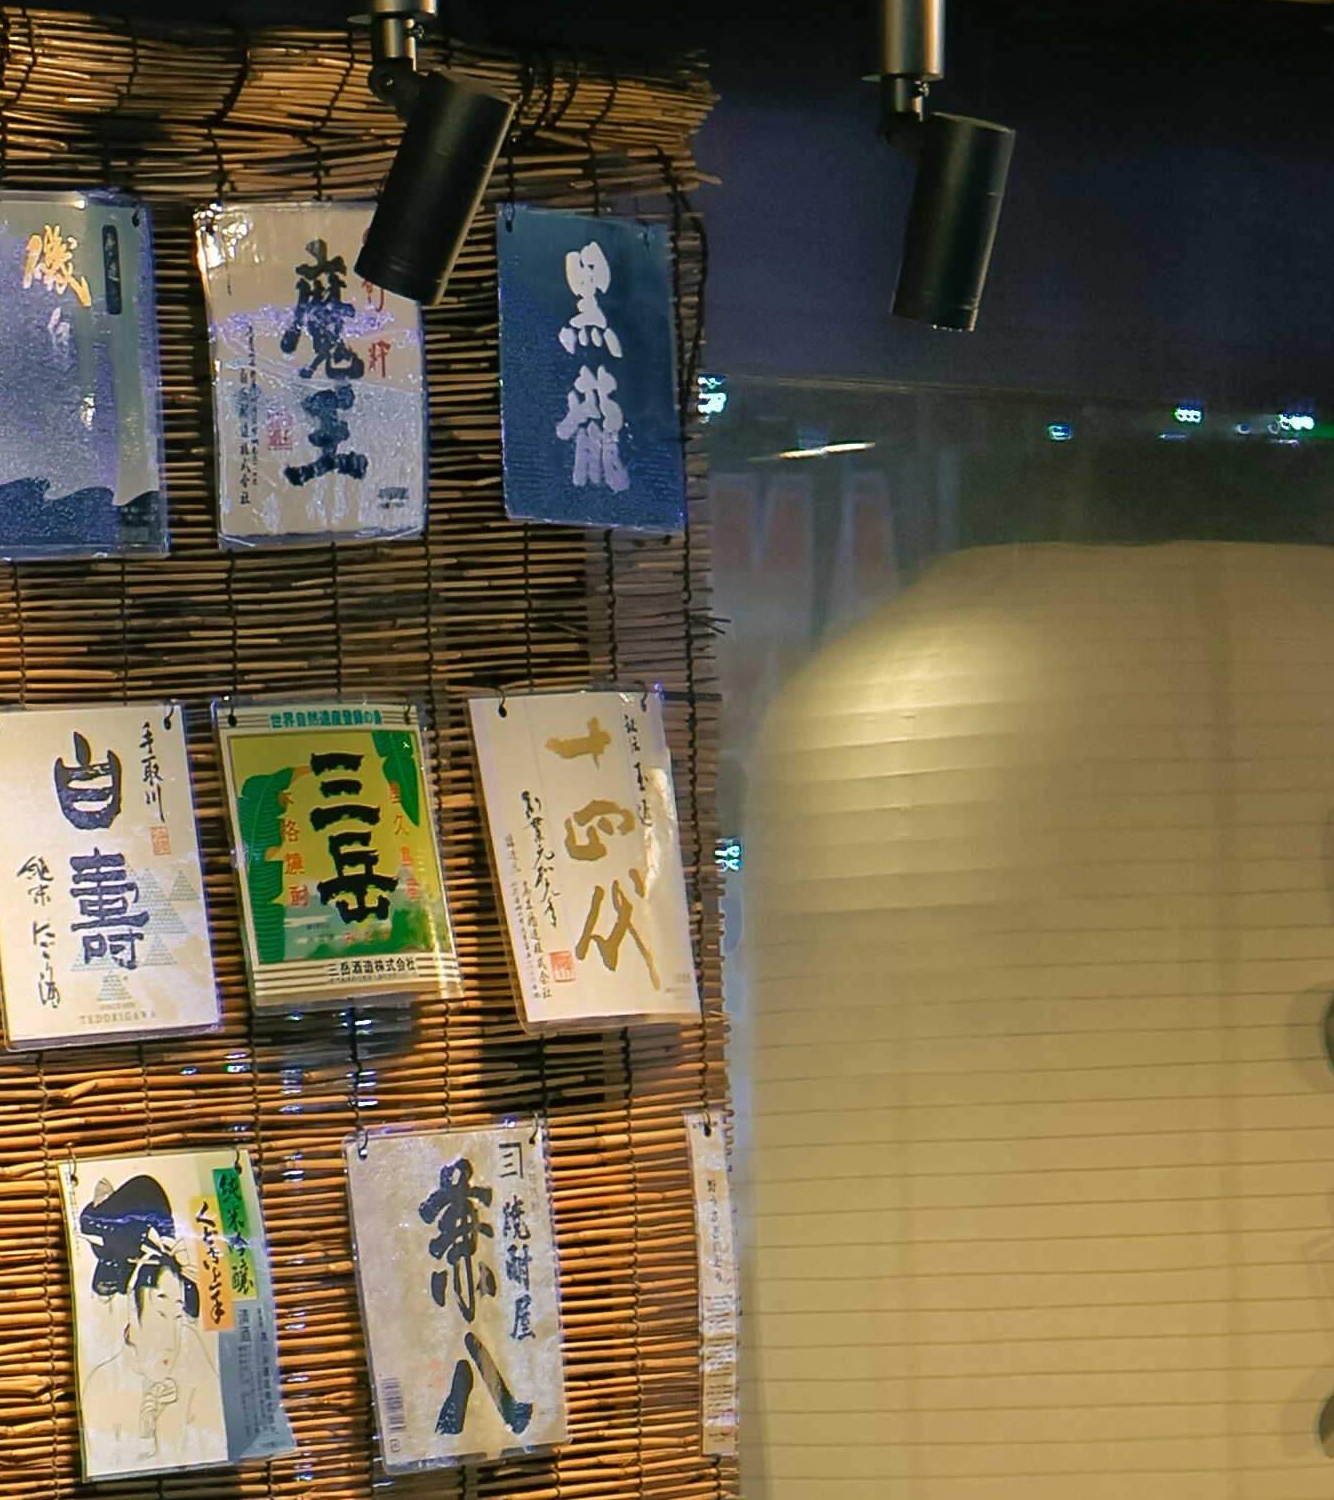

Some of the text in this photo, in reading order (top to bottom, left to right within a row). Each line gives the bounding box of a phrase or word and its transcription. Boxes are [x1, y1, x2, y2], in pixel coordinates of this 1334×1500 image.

[279, 238, 370, 488] 魔王
[556, 241, 630, 493] 黒龍
[138, 721, 166, 822] 手取川
[545, 716, 660, 991] 十四代
[326, 957, 417, 977] 三岳酒造株式会社
